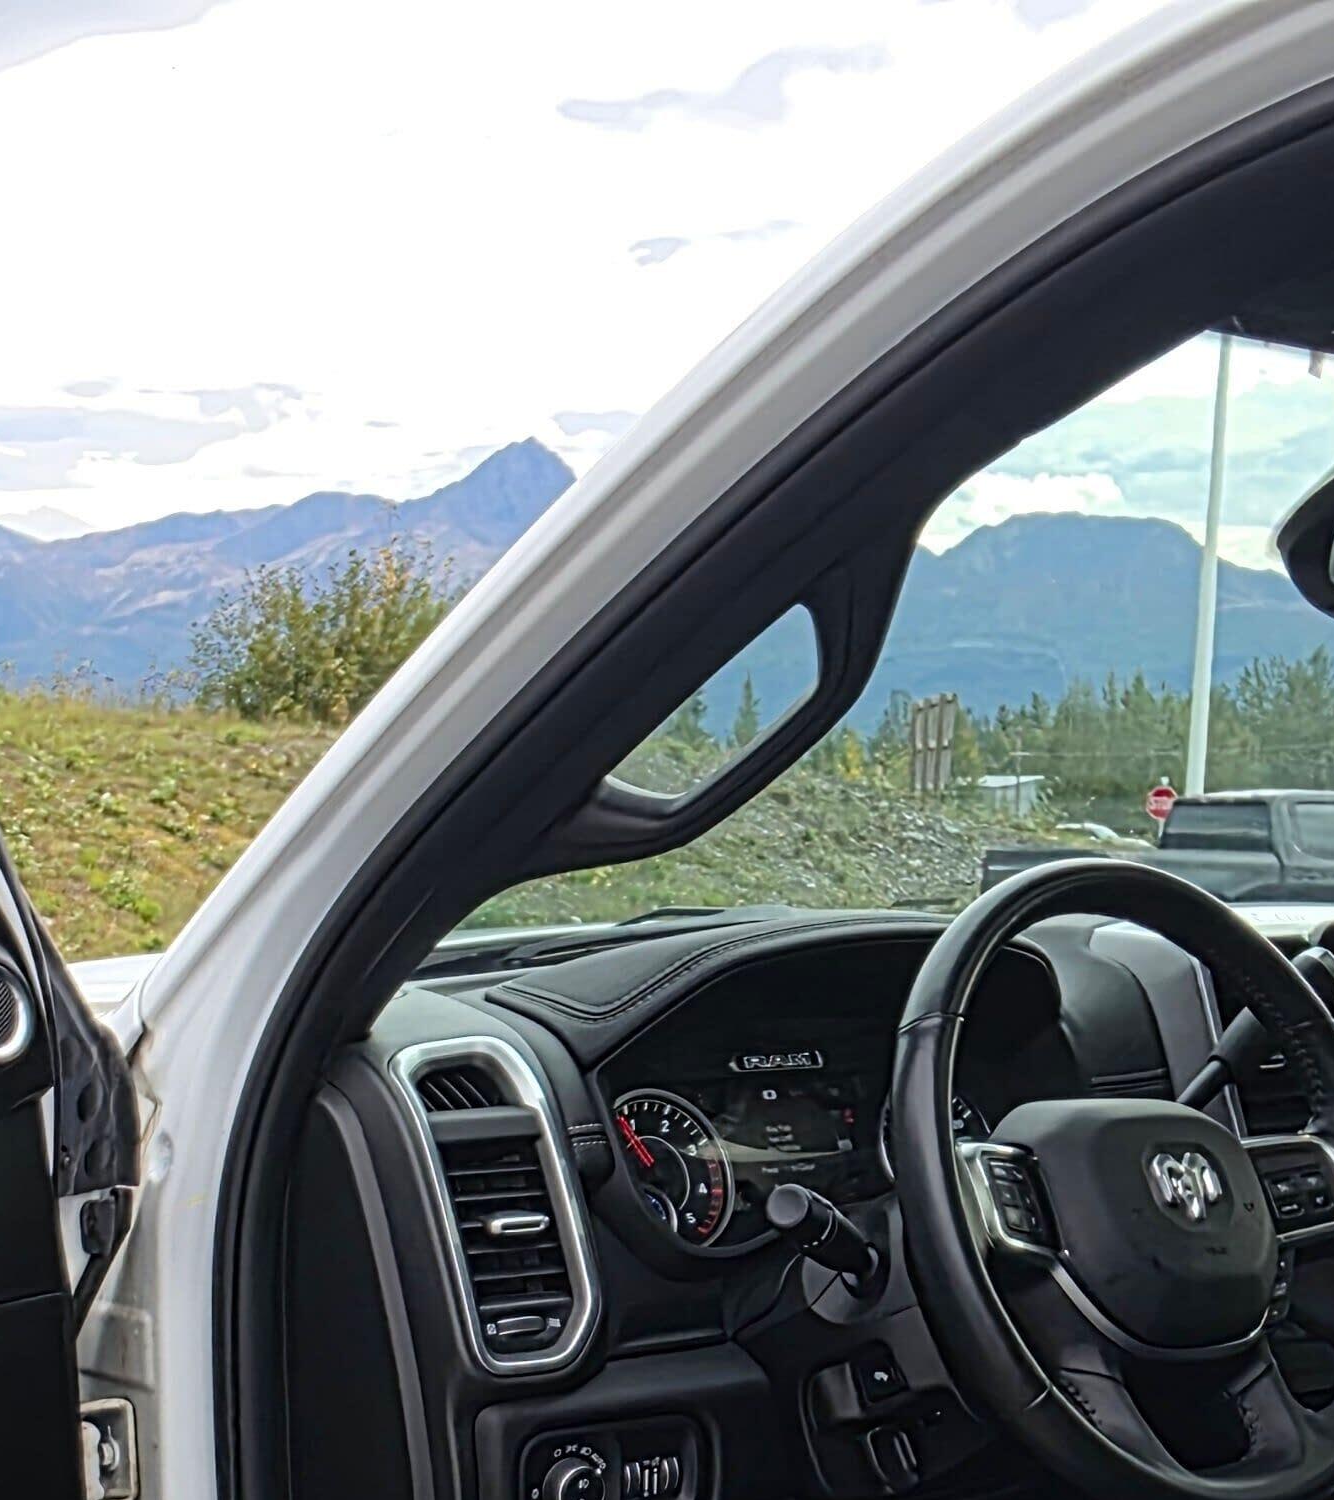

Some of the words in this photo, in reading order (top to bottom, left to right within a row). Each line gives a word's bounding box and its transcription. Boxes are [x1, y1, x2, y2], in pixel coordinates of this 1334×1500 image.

[743, 1053, 811, 1069] RAM
[661, 1120, 670, 1132] 2
[687, 1144, 697, 1156] 3
[698, 1183, 708, 1194] 4
[686, 1212, 696, 1224] 5
